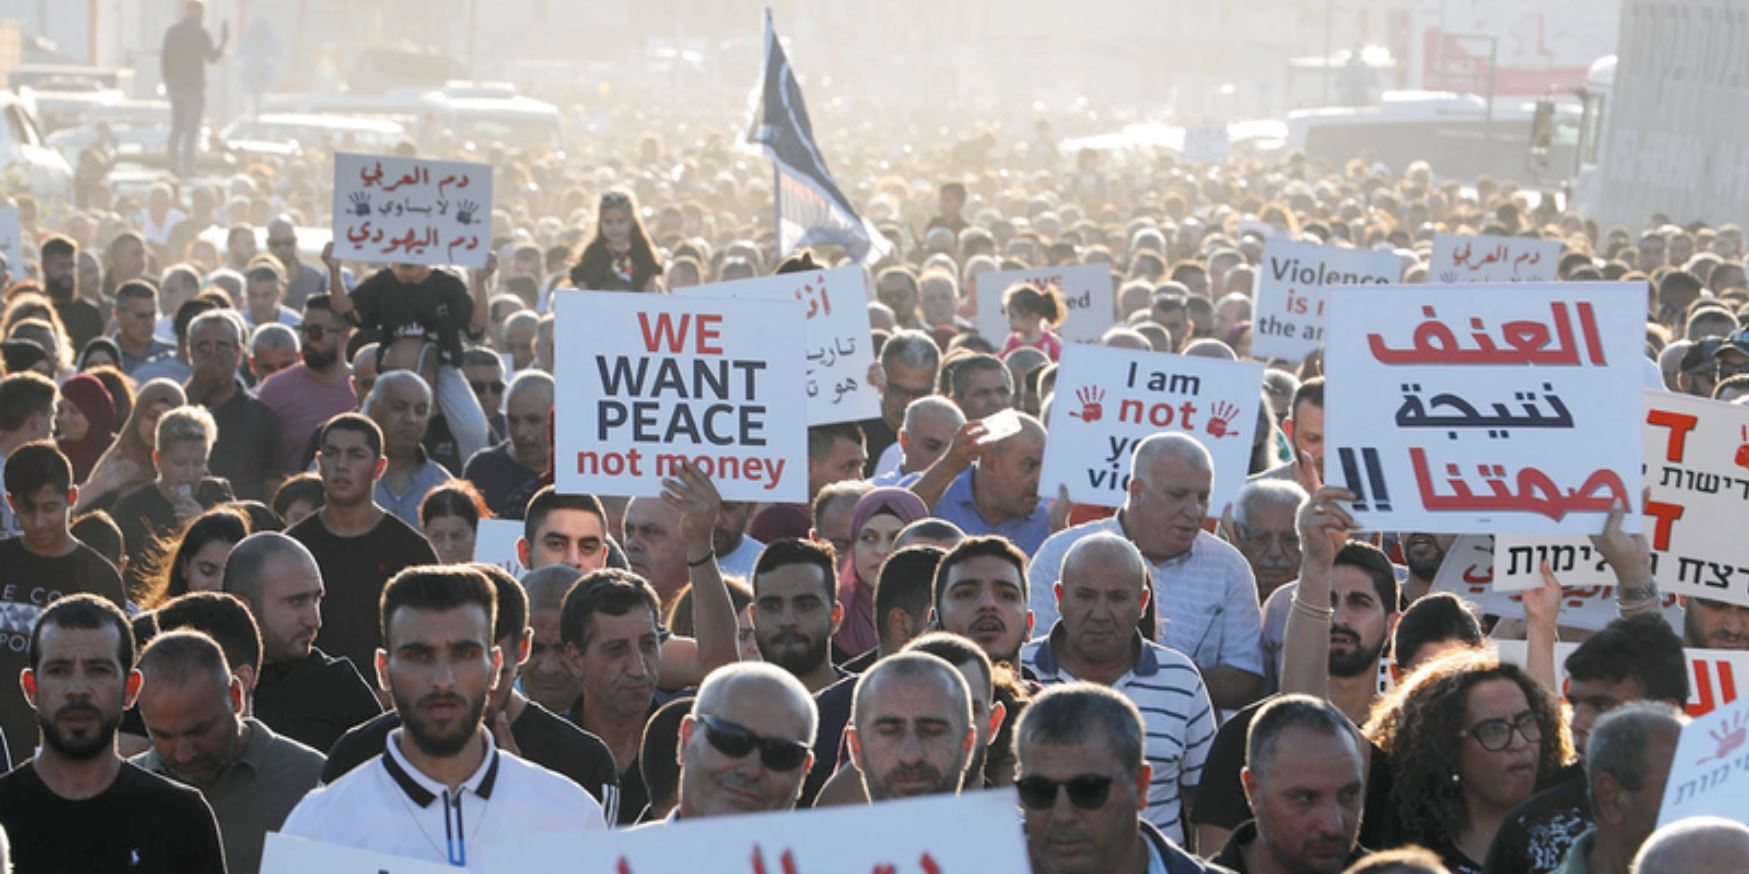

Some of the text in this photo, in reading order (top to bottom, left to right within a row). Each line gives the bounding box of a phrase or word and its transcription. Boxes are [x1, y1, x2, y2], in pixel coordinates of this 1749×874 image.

[360, 161, 470, 197] دم العربي
[346, 220, 480, 262] دم اليهودي
[1286, 287, 1309, 315] is
[637, 311, 724, 356] WE
[1258, 315, 1297, 338] the
[1366, 301, 1608, 367] العنف
[595, 354, 767, 402] WANT
[1126, 361, 1200, 396] I am
[597, 399, 767, 446] PEACE
[1118, 398, 1198, 431] not
[1394, 382, 1575, 440] نتيجة
[576, 447, 786, 490] not money
[1408, 447, 1633, 523] صمتنا
